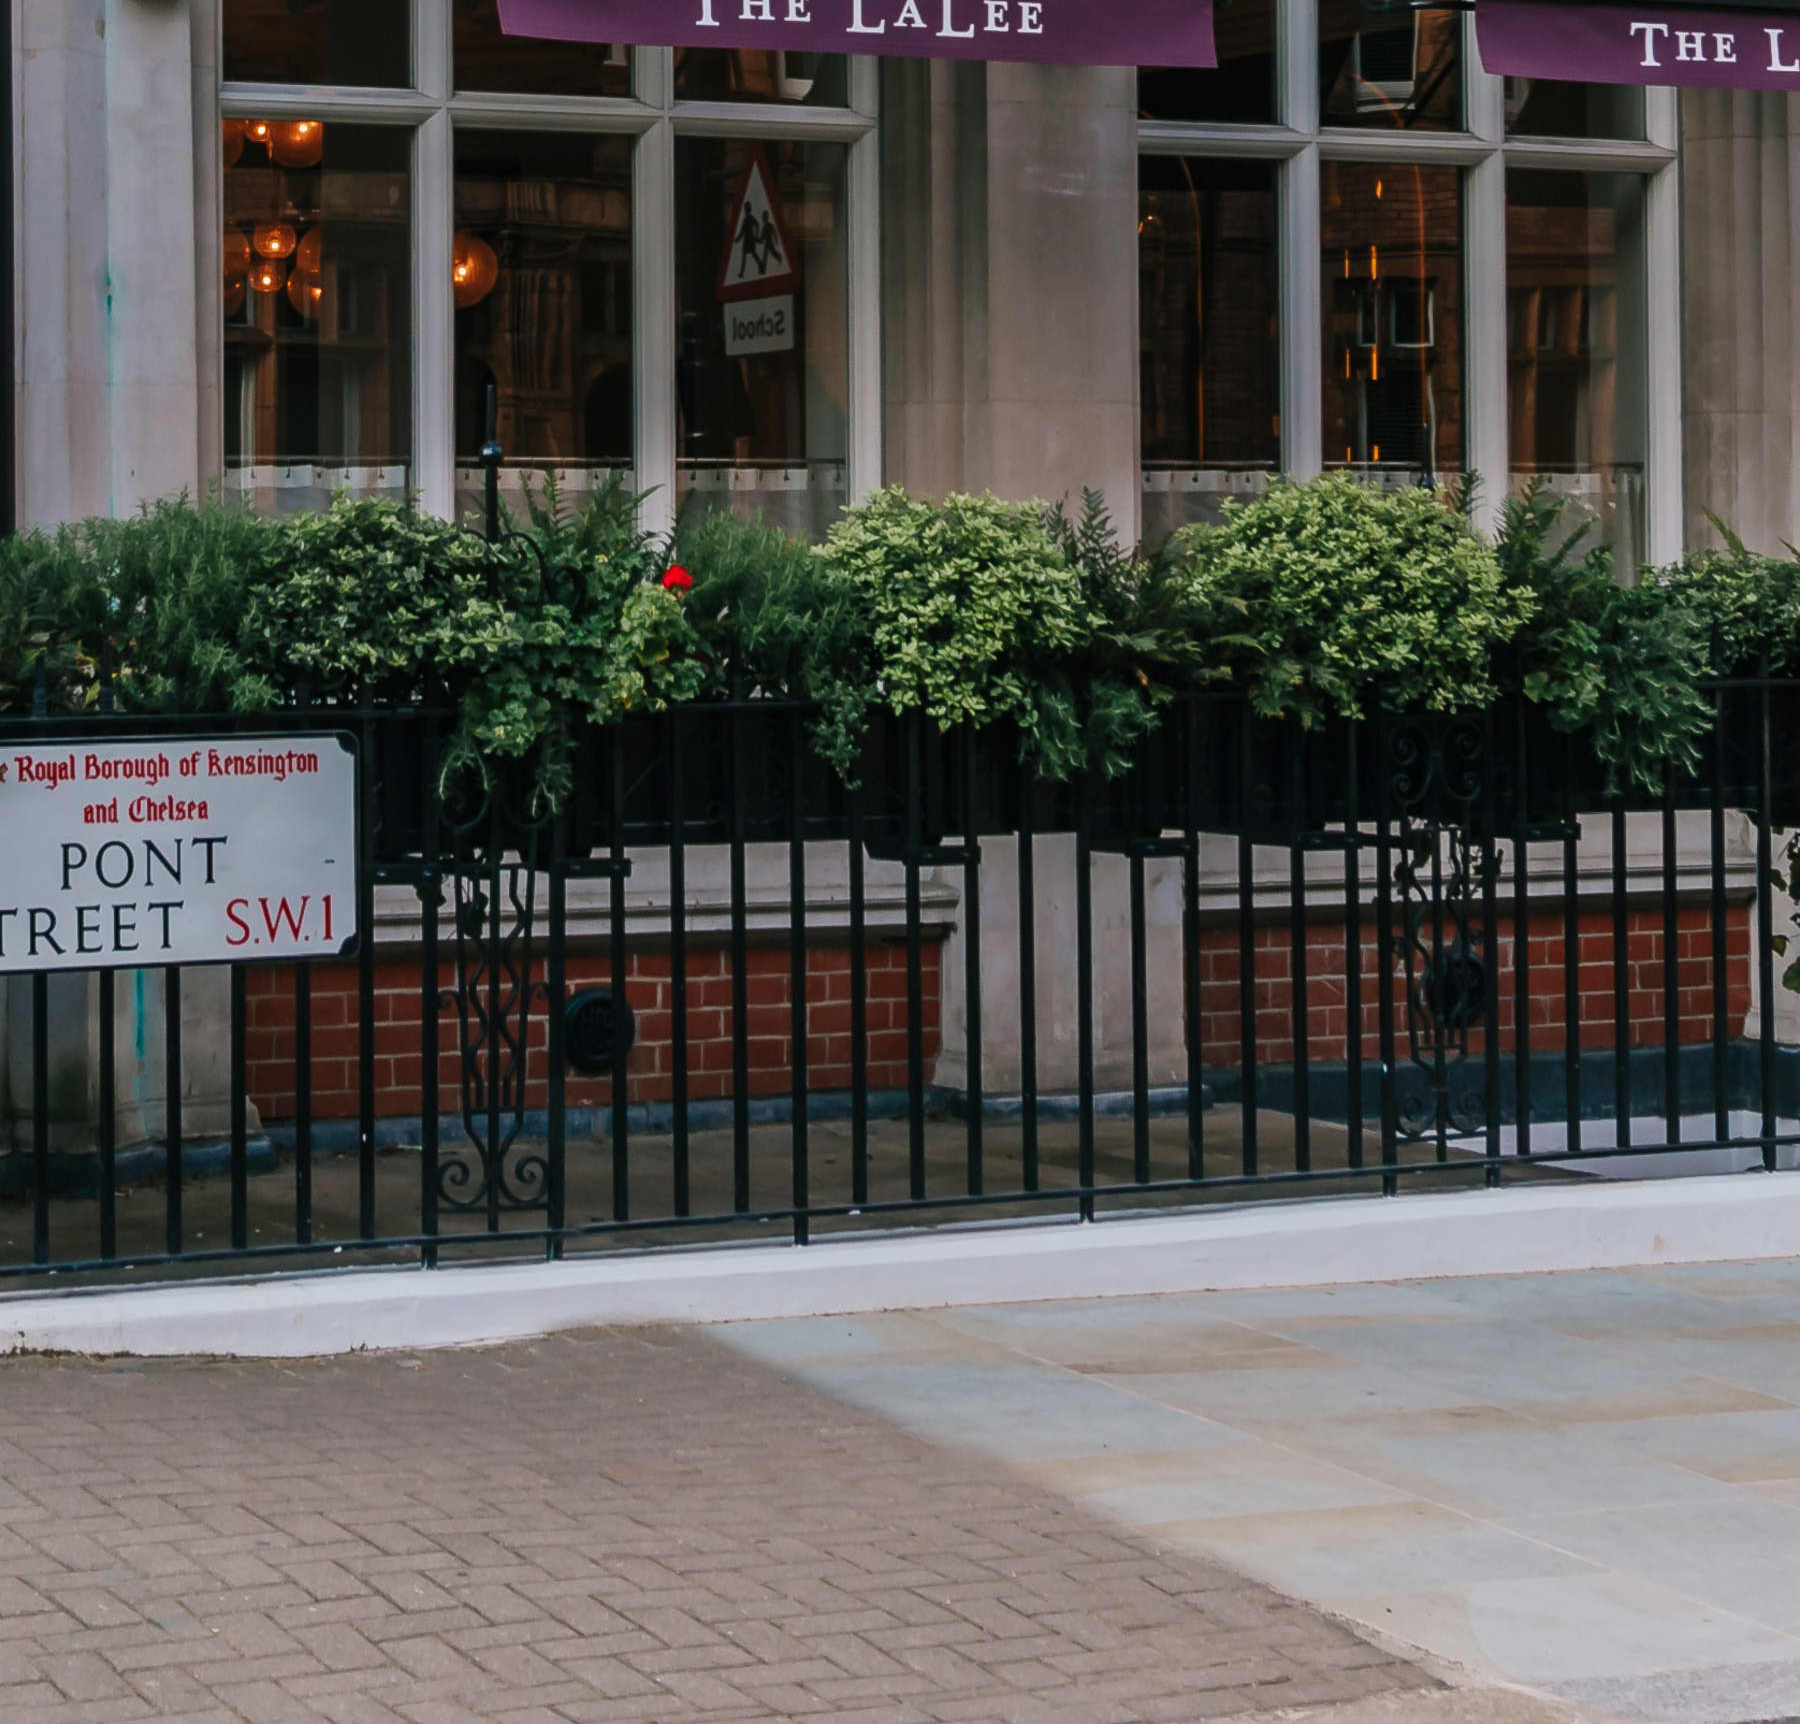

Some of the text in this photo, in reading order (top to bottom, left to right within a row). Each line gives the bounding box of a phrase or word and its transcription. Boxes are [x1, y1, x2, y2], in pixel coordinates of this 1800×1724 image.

[14, 753, 76, 790] Royal
[84, 753, 170, 786] Borough
[179, 751, 202, 777] of
[208, 748, 318, 782] Kensington
[83, 796, 209, 824] and Chelsea
[61, 836, 228, 890] PONT
[225, 894, 334, 946] S.W.1
